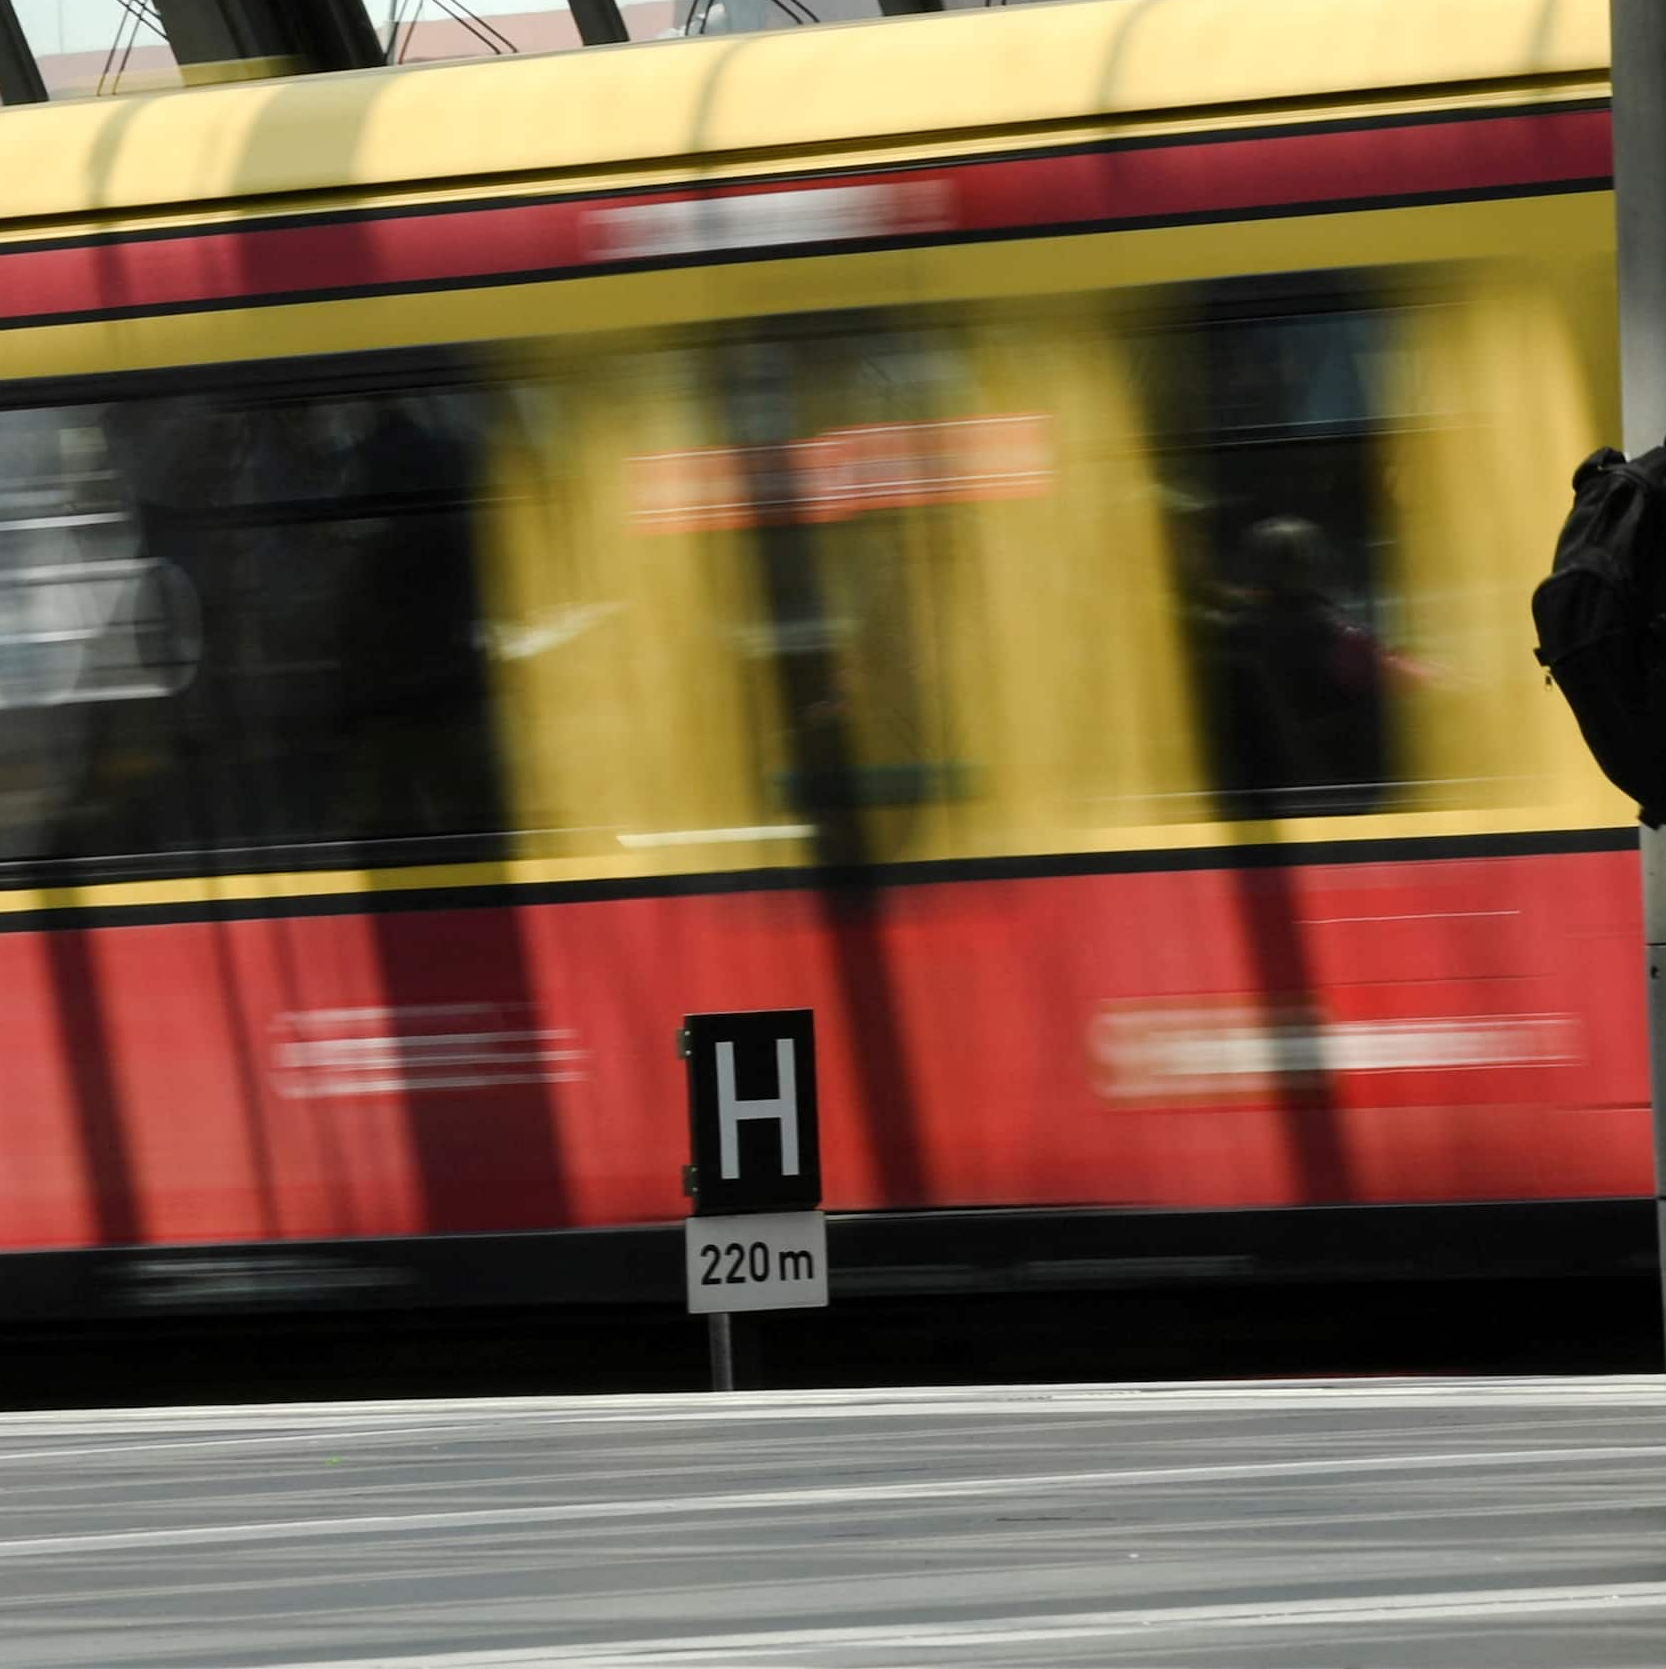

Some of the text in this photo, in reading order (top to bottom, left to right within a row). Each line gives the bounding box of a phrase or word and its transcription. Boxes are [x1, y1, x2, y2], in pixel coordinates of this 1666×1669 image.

[714, 1037, 800, 1180] H
[700, 1241, 814, 1286] 220 m
